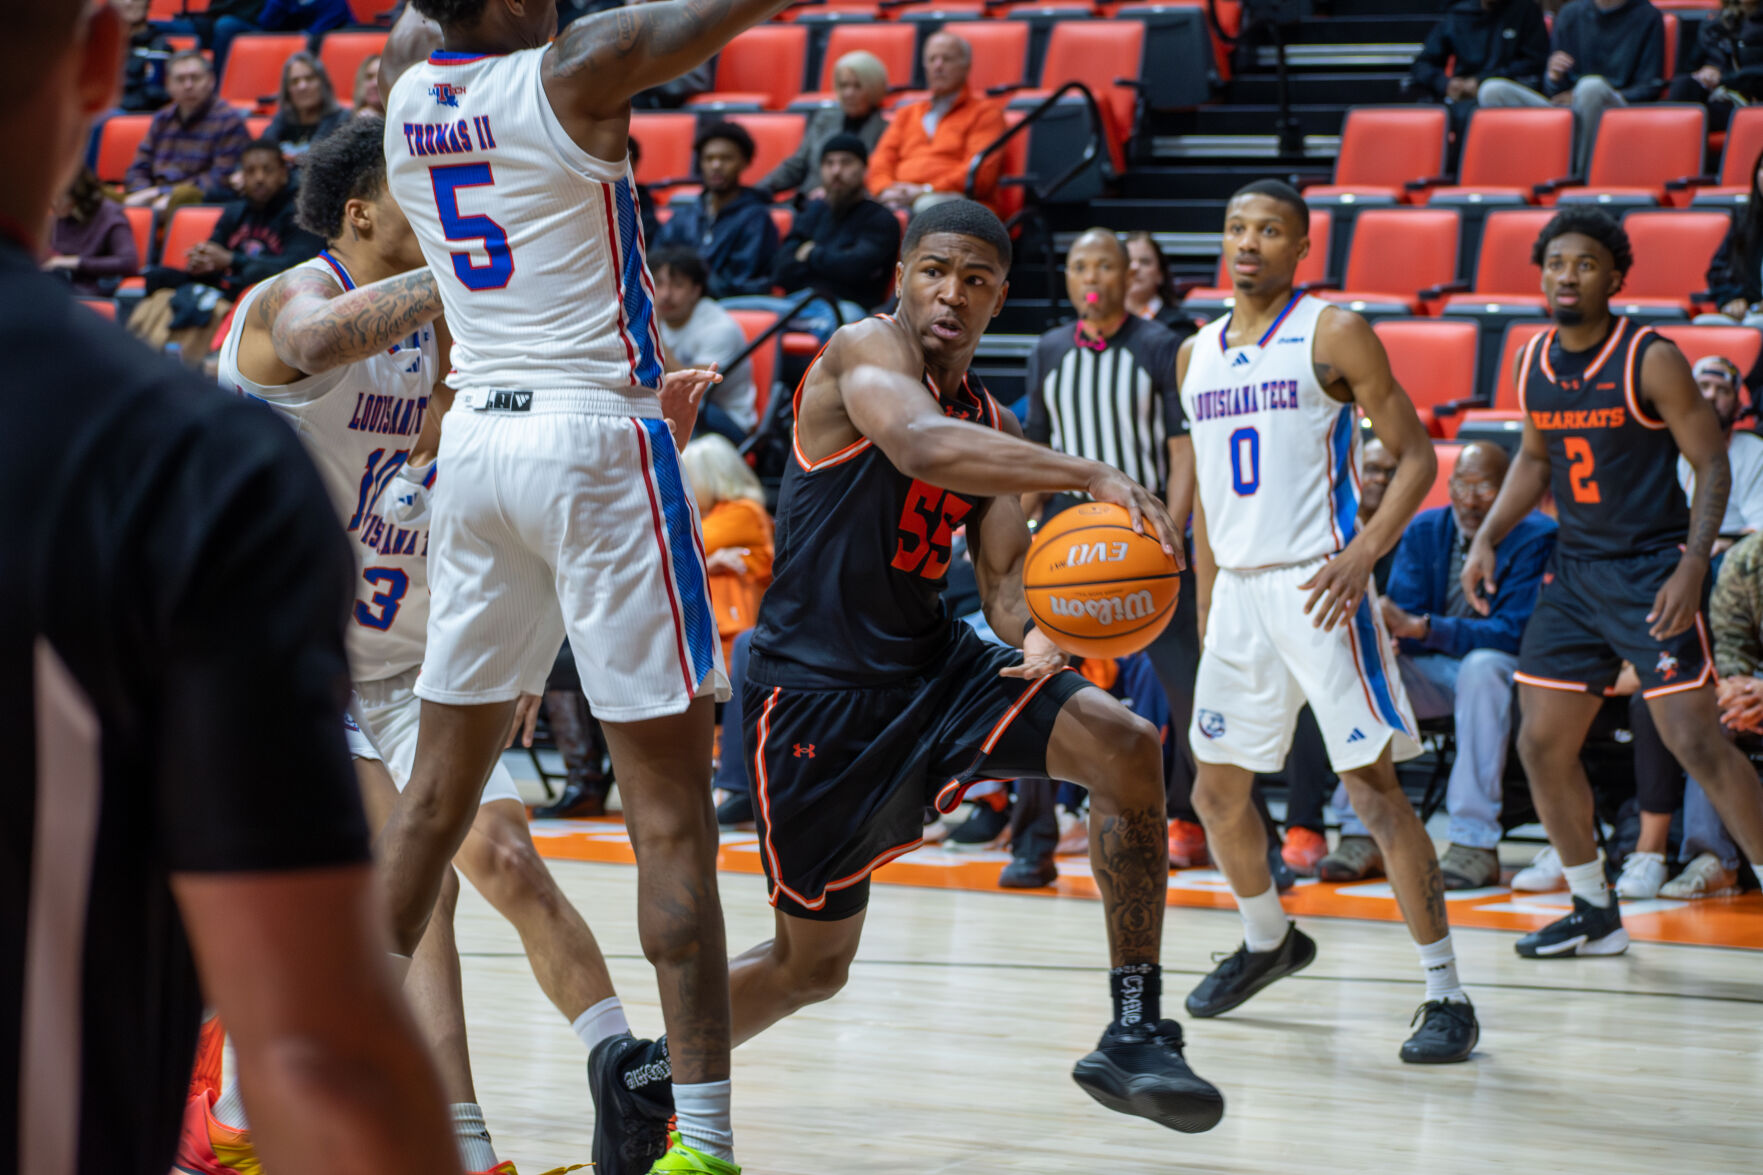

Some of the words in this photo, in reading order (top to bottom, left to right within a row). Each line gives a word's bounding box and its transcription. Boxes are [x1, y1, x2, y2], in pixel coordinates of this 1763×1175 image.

[403, 118, 473, 157] THOMAS
[473, 115, 497, 151] II
[429, 162, 515, 292] 5
[1262, 379, 1298, 411] TECH
[1229, 426, 1260, 498] 0
[1563, 436, 1602, 504] 2
[889, 477, 973, 579] 55
[1067, 541, 1128, 567] EVO
[353, 566, 409, 632] 3
[1050, 590, 1156, 626] Wilson
